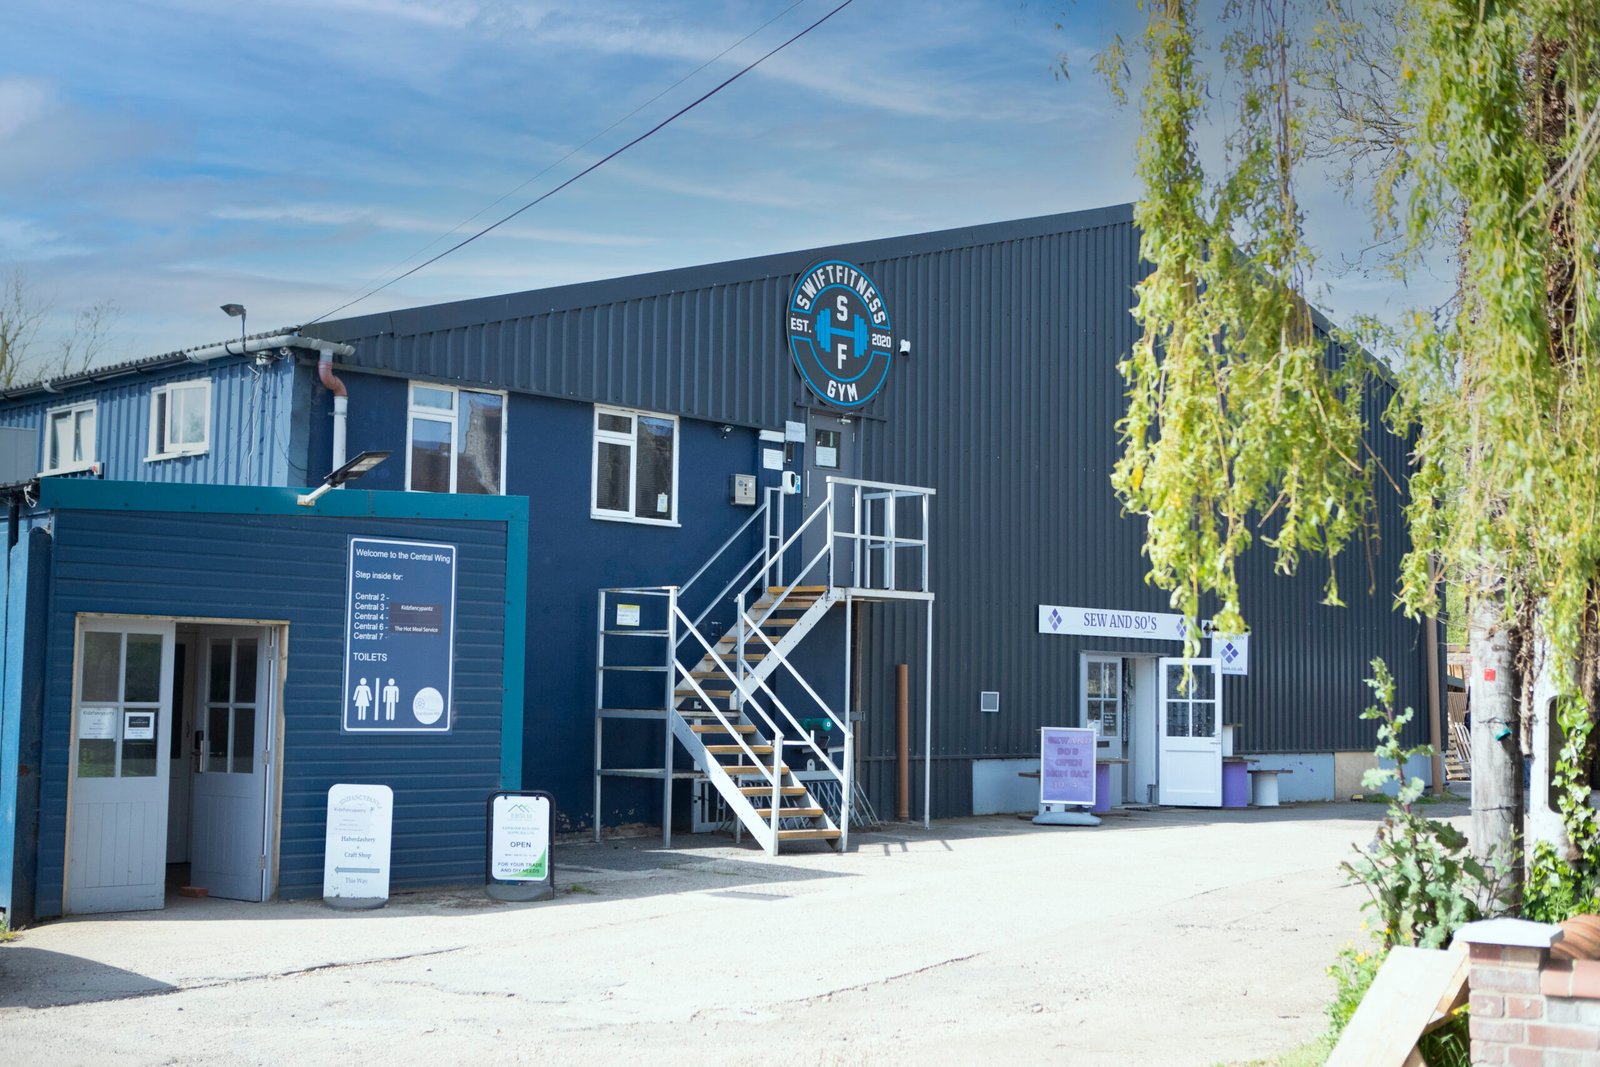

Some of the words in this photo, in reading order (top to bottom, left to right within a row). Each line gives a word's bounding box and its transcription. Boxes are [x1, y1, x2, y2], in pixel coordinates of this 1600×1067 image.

[836, 295, 848, 322] S
[790, 318, 812, 333] EST.
[872, 333, 892, 348] 2020
[837, 343, 848, 369] F
[826, 380, 858, 402] GYM
[356, 548, 388, 558] Welcome
[410, 552, 433, 561] Central
[434, 555, 450, 564] Wing
[355, 571, 371, 579] Step
[355, 592, 379, 600] Central
[355, 602, 379, 610] Central
[354, 622, 378, 630] Central
[1084, 612, 1108, 627] SEW
[1109, 614, 1132, 628] AND
[1134, 615, 1157, 630] SO'S
[354, 632, 378, 640] Central
[353, 652, 388, 661] TOILETS
